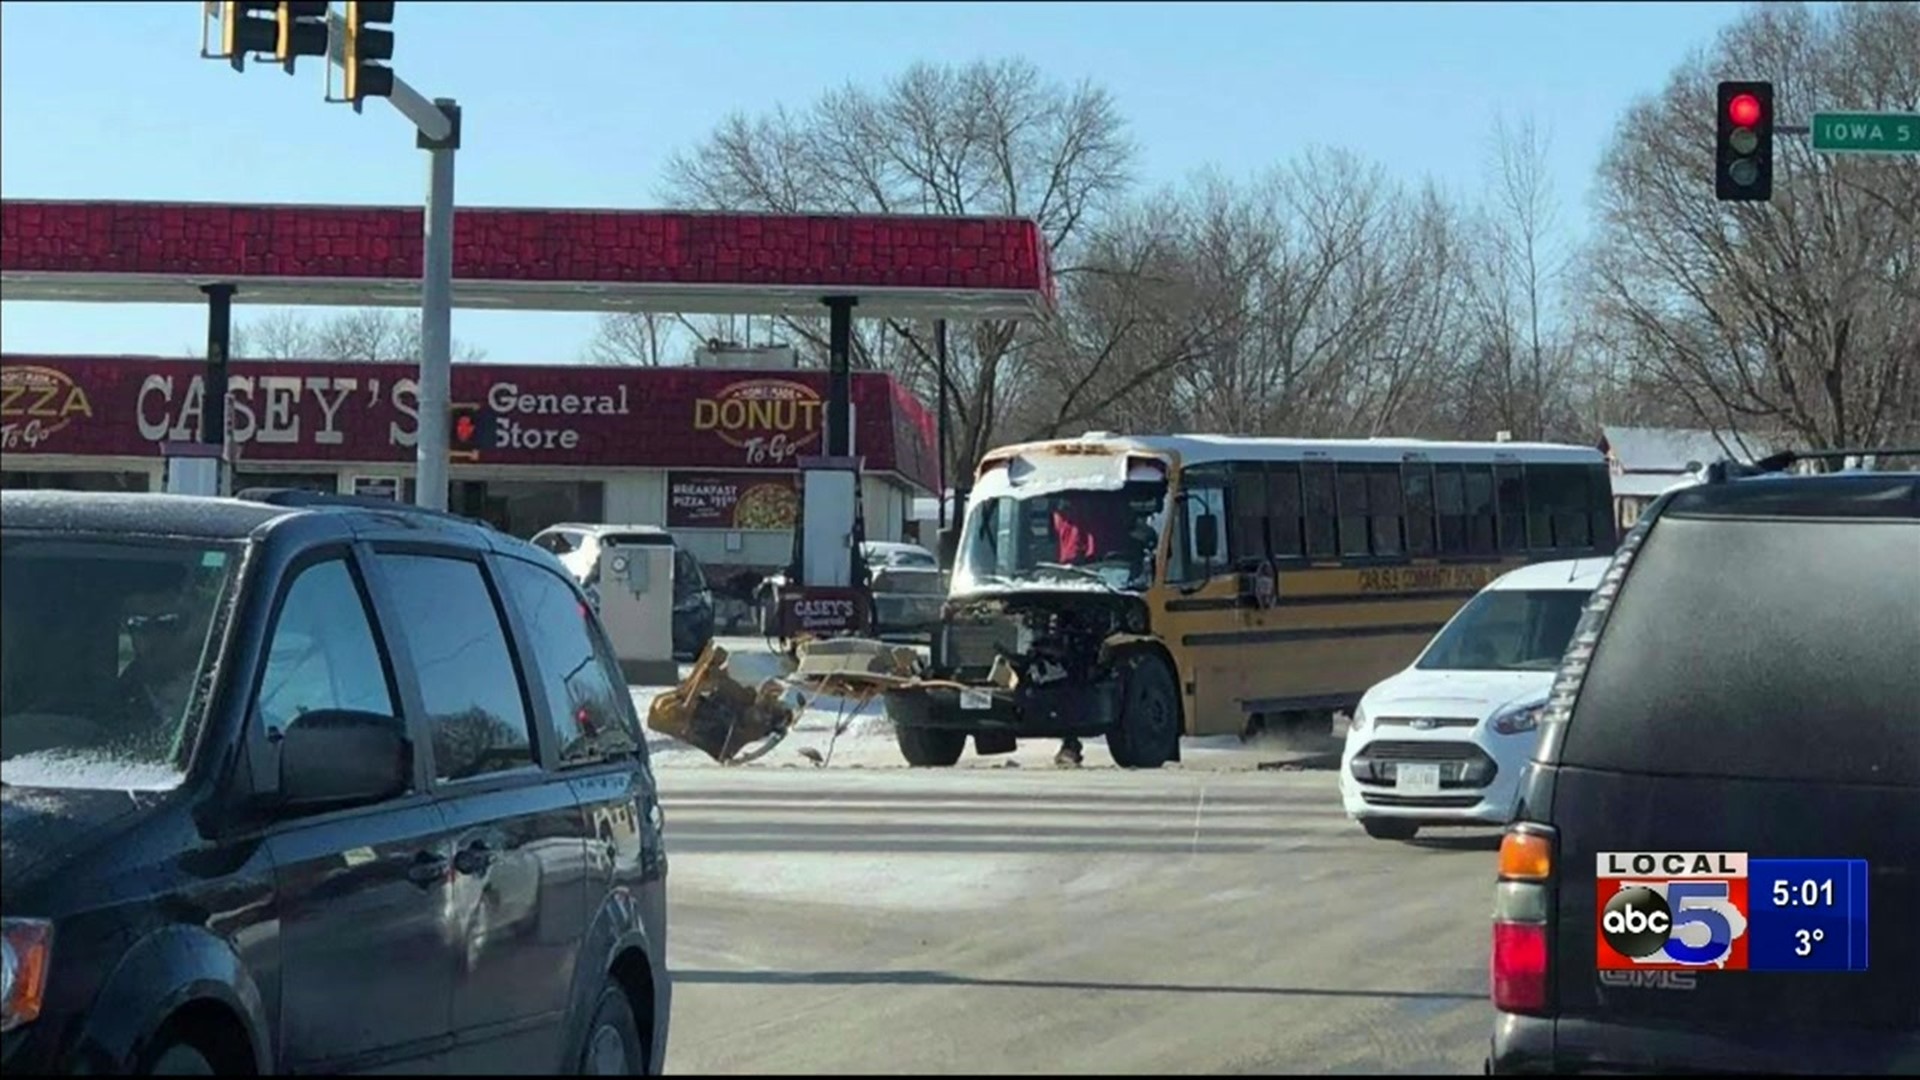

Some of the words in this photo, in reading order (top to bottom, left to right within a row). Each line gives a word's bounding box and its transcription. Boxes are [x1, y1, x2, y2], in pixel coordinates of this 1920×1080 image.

[1825, 123, 1884, 140] IOWA
[137, 373, 420, 448] CASEY'S
[488, 382, 630, 415] General
[694, 398, 830, 431] DONUT
[744, 436, 765, 464] To
[769, 433, 796, 463] Go
[673, 484, 737, 496] BREAKFAST
[673, 496, 705, 507] PIZZA
[794, 600, 854, 617] CASEY'S
